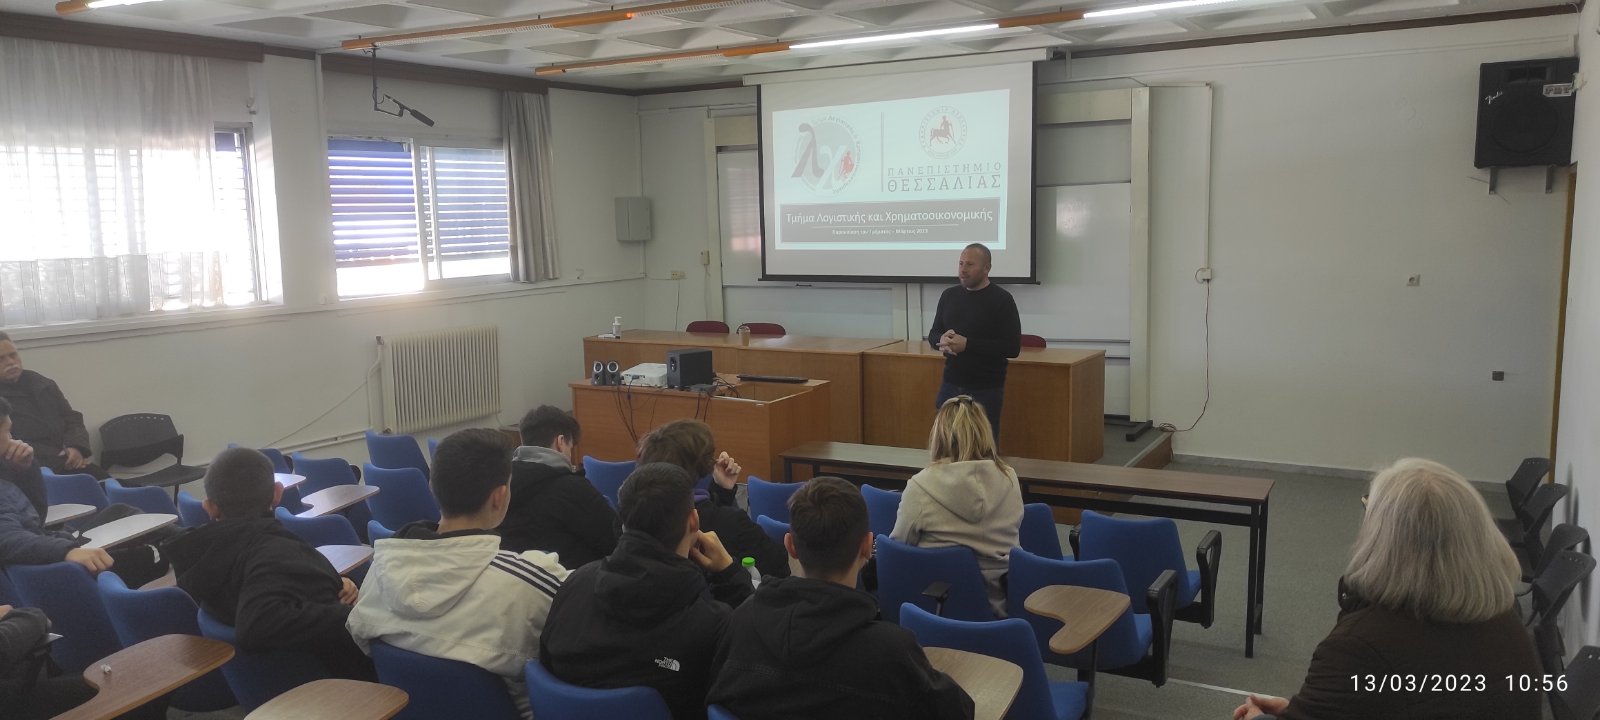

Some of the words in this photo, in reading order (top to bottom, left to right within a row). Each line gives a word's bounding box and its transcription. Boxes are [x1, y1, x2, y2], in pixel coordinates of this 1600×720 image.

[887, 161, 1002, 177] ΠΑΝΕΠΙΣΤΗΜΙΟ
[887, 174, 1001, 193] ΘΕΣΣΑΛΙΑΣ
[785, 211, 815, 225] Τμήμα
[816, 209, 866, 224] Λογιστικής
[868, 211, 884, 222] και
[885, 207, 993, 224] Χρηματοοικονομικής
